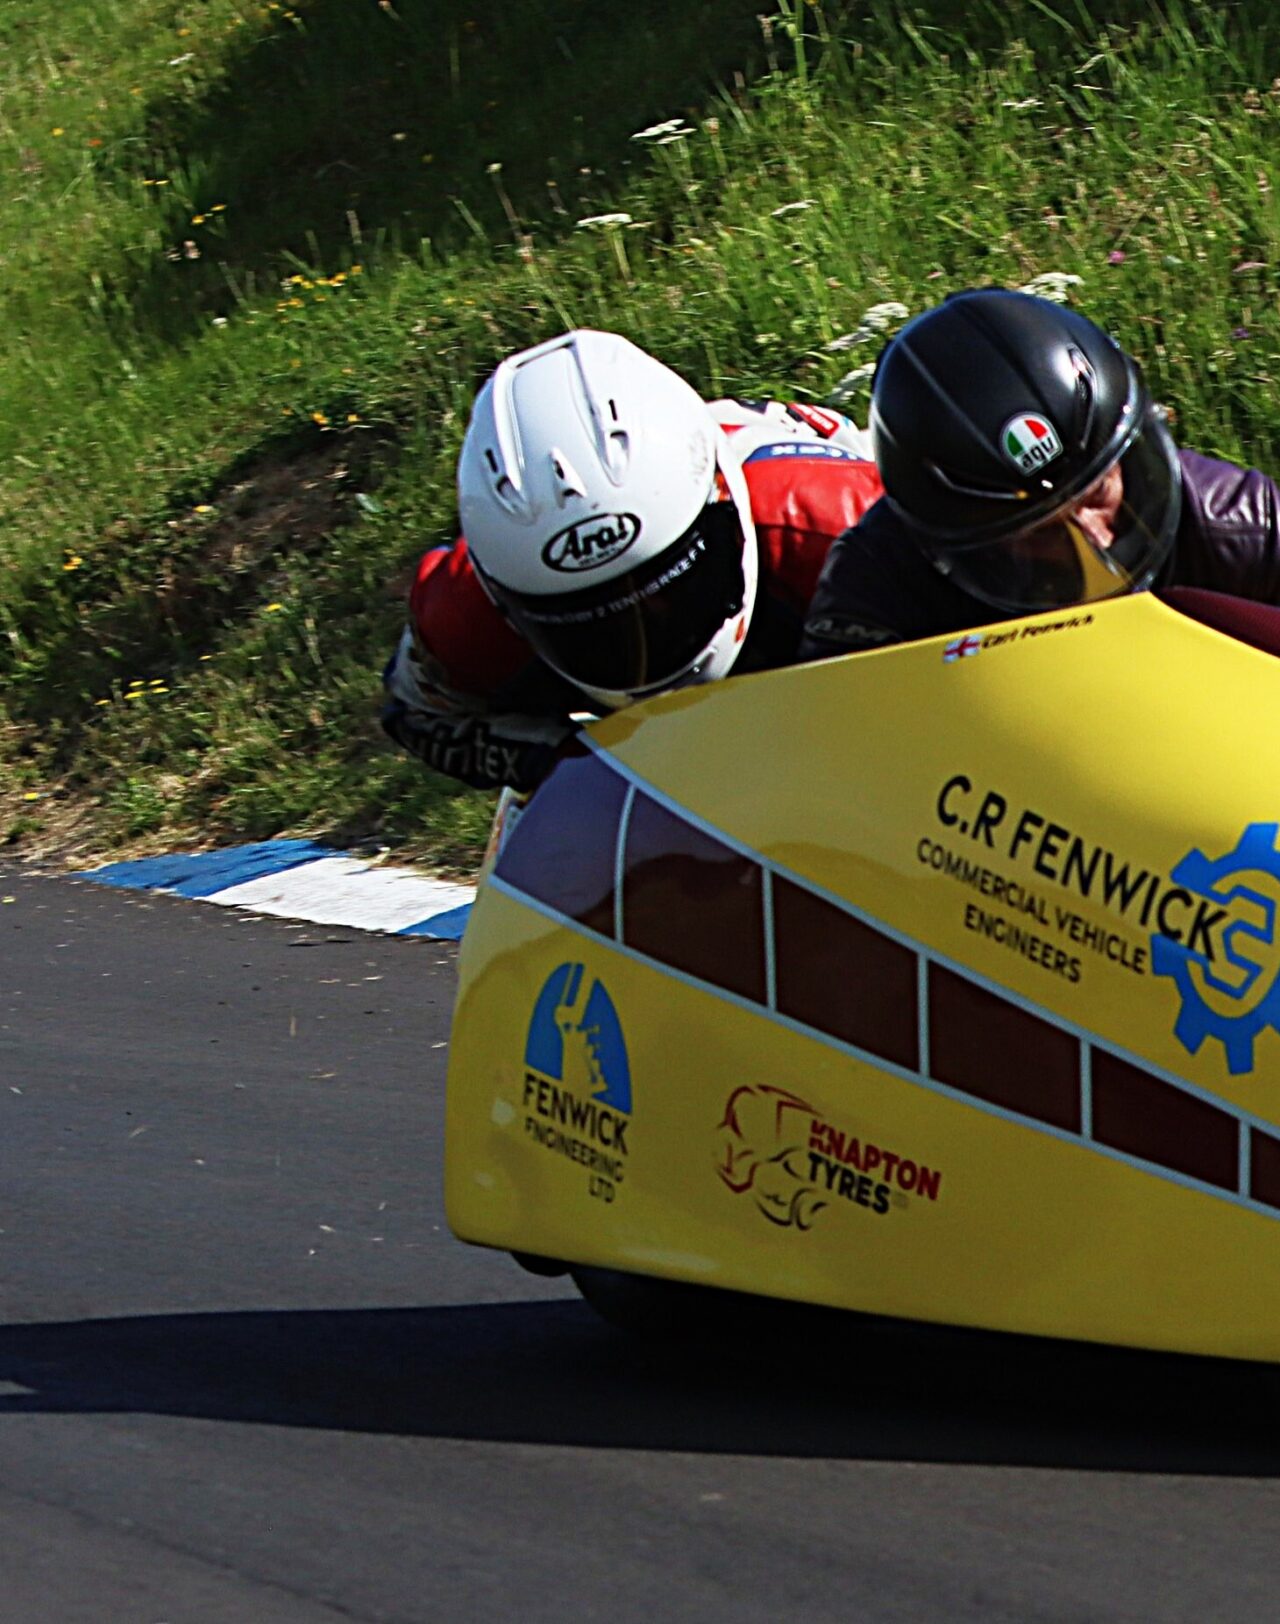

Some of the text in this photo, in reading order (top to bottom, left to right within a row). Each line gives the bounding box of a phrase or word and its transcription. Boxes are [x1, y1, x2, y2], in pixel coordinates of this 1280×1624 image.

[554, 514, 629, 565] Arai
[916, 838, 1148, 975] COMMERCIAL VEHICLE
[937, 775, 1228, 962] C.R FENWICK
[964, 903, 1082, 984] ENGINEERS
[523, 1072, 629, 1155] FENWICK
[808, 1151, 890, 1215] TYRES
[809, 1119, 941, 1200] KNAPTON
